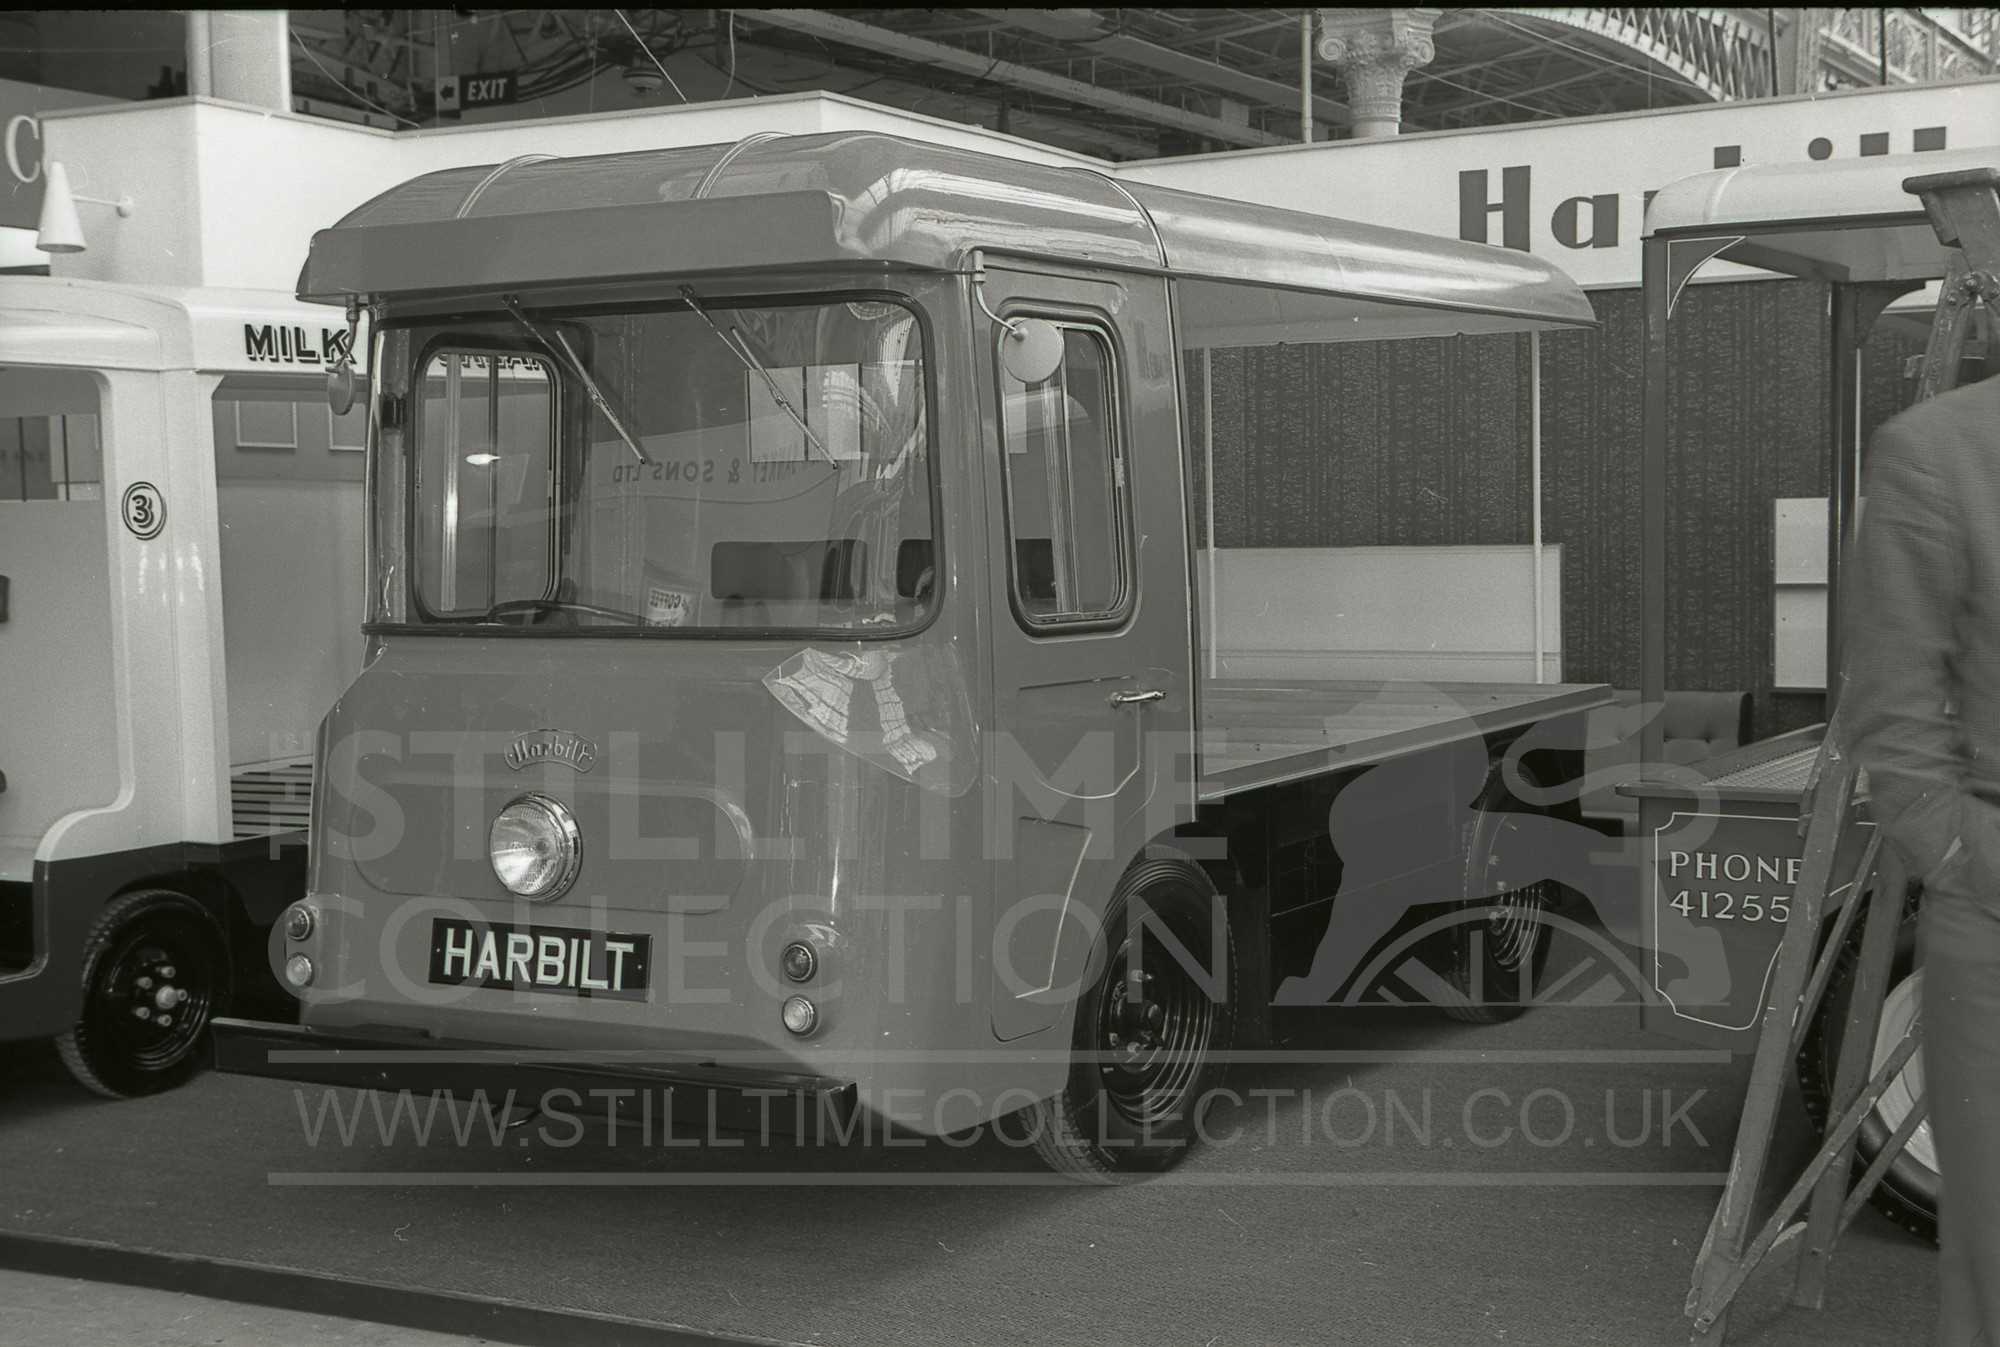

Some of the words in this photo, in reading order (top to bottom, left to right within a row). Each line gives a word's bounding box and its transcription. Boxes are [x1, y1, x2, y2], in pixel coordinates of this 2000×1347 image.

[467, 78, 507, 101] EXIT
[244, 323, 357, 364] MILK
[132, 494, 154, 528] 3
[1669, 890, 1791, 923] 41255
[443, 928, 634, 992] HARBILT
